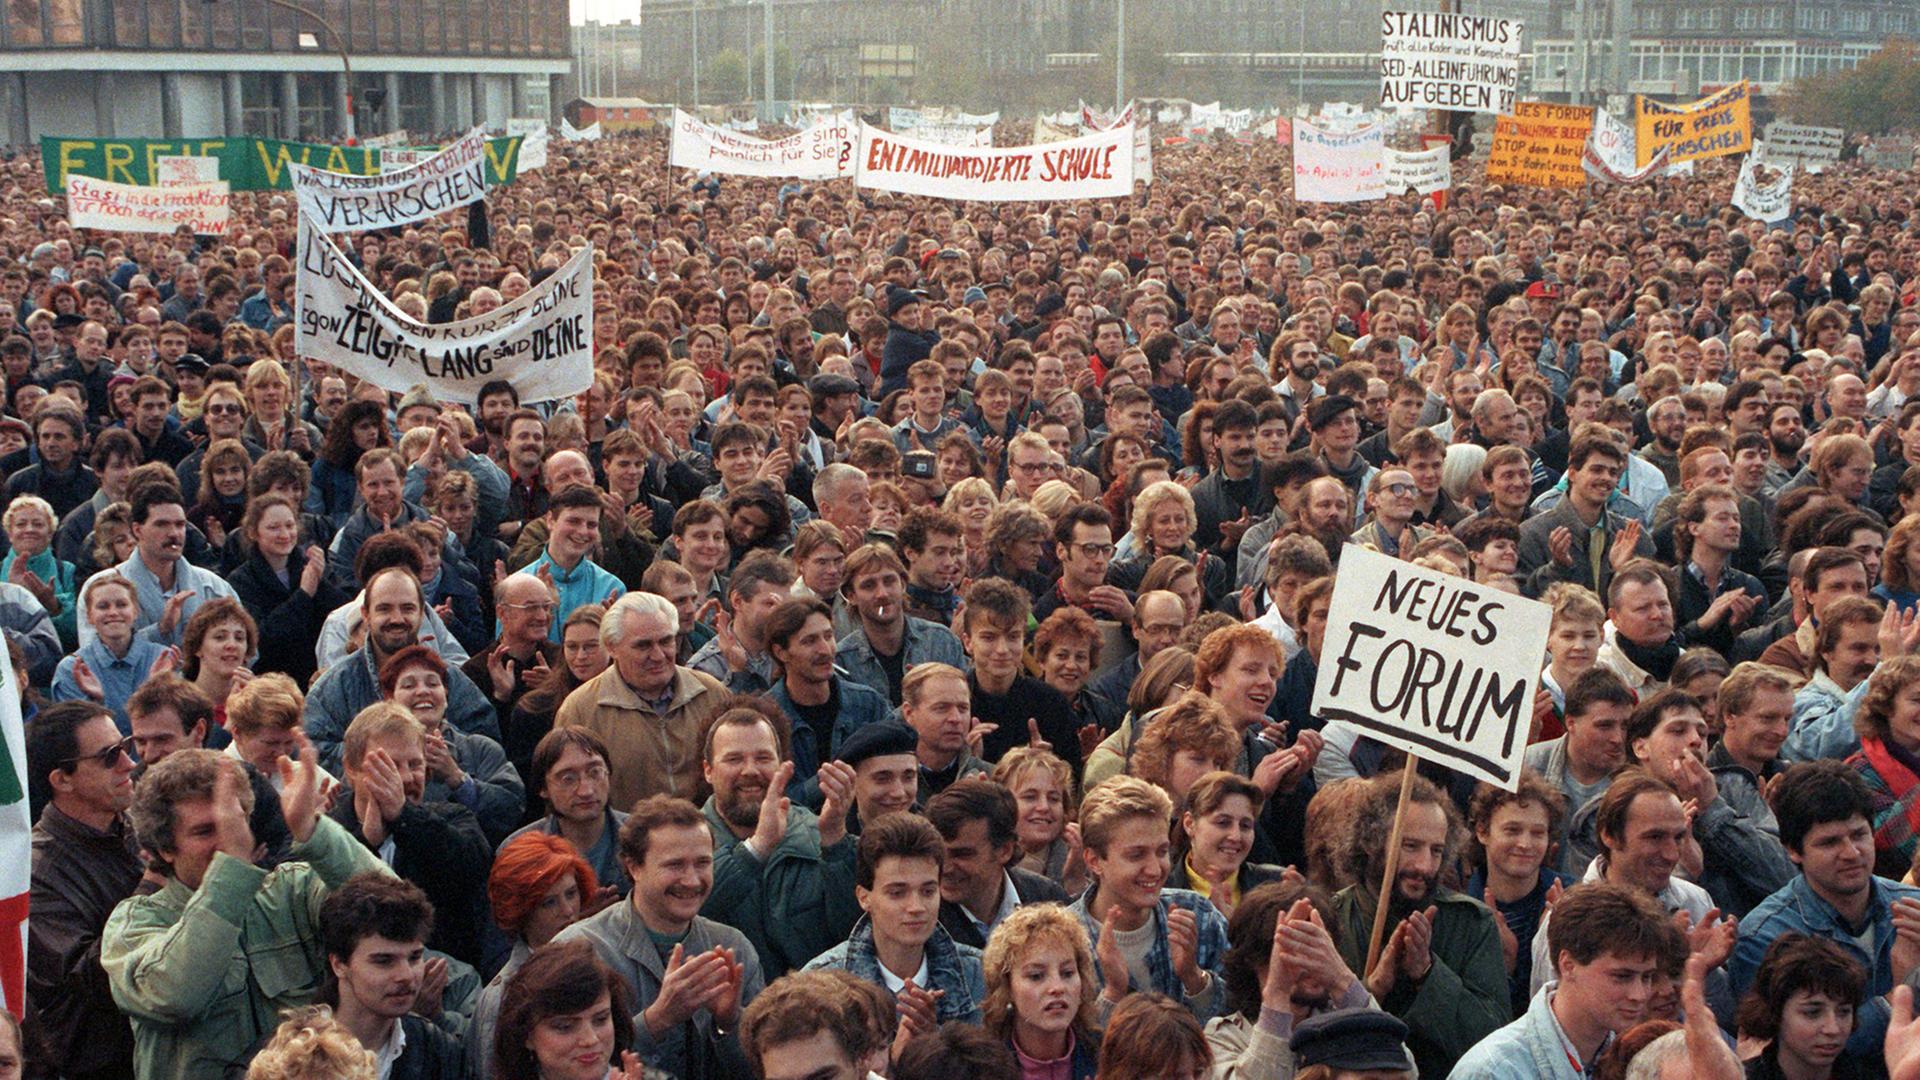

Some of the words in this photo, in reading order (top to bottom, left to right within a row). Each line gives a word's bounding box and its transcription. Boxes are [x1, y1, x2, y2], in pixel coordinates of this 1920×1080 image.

[1382, 11, 1509, 43] STALINISMUS
[1381, 81, 1491, 108] AUFGEBEN
[1515, 103, 1541, 118] UES
[1546, 106, 1592, 121] FORUM
[1653, 119, 1684, 138] FÜR
[1693, 108, 1735, 132] FREIE
[812, 125, 848, 143] sind
[1495, 139, 1526, 153] STOP
[59, 141, 226, 188] FRE
[329, 174, 383, 190] LASSEN
[418, 148, 462, 178] NICHT
[782, 147, 804, 164] für
[812, 144, 836, 160] Sie
[1040, 144, 1118, 182] SCHULE
[70, 180, 120, 203] Stasi
[314, 164, 485, 226] VERARSCHEN
[443, 306, 527, 339] KURZE
[420, 345, 493, 380] LANG
[1373, 570, 1504, 645] NEUES
[1330, 621, 1527, 759] FORUM
